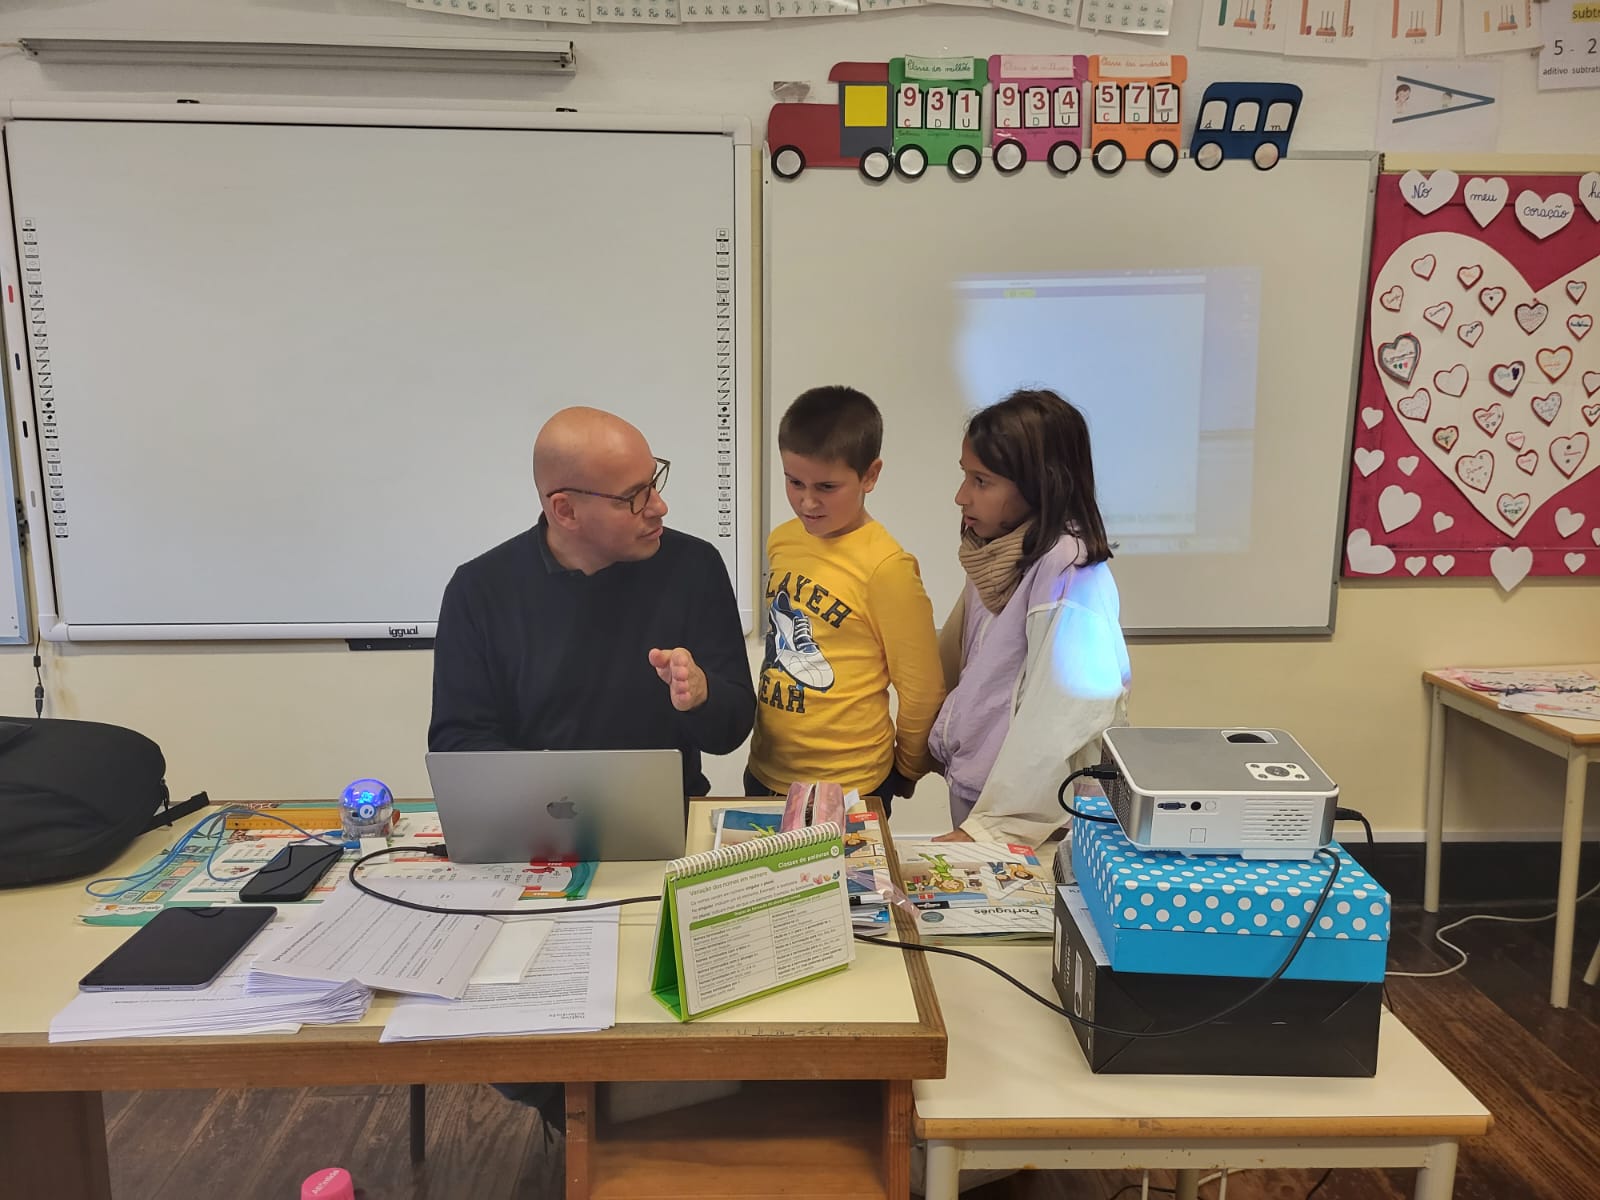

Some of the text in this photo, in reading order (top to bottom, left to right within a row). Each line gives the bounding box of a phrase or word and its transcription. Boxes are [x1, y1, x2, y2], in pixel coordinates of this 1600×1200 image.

[1554, 40, 1563, 55] 5
[1588, 38, 1597, 54] 2
[1543, 67, 1568, 75] aditivo
[903, 86, 970, 113] 9 3 1
[1002, 86, 1075, 110] 9 3 4
[1101, 85, 1170, 106] 5 7 7
[934, 118, 942, 128] D
[962, 118, 970, 128] U
[1032, 116, 1040, 126] D
[1061, 114, 1071, 125] U
[1132, 112, 1140, 122] D
[1161, 111, 1169, 122] U
[1411, 181, 1432, 199] No
[1470, 193, 1498, 202] meu
[1523, 204, 1569, 219] coração
[765, 572, 852, 628] LAYER
[388, 625, 418, 637] iggual
[974, 907, 1039, 916] Português
